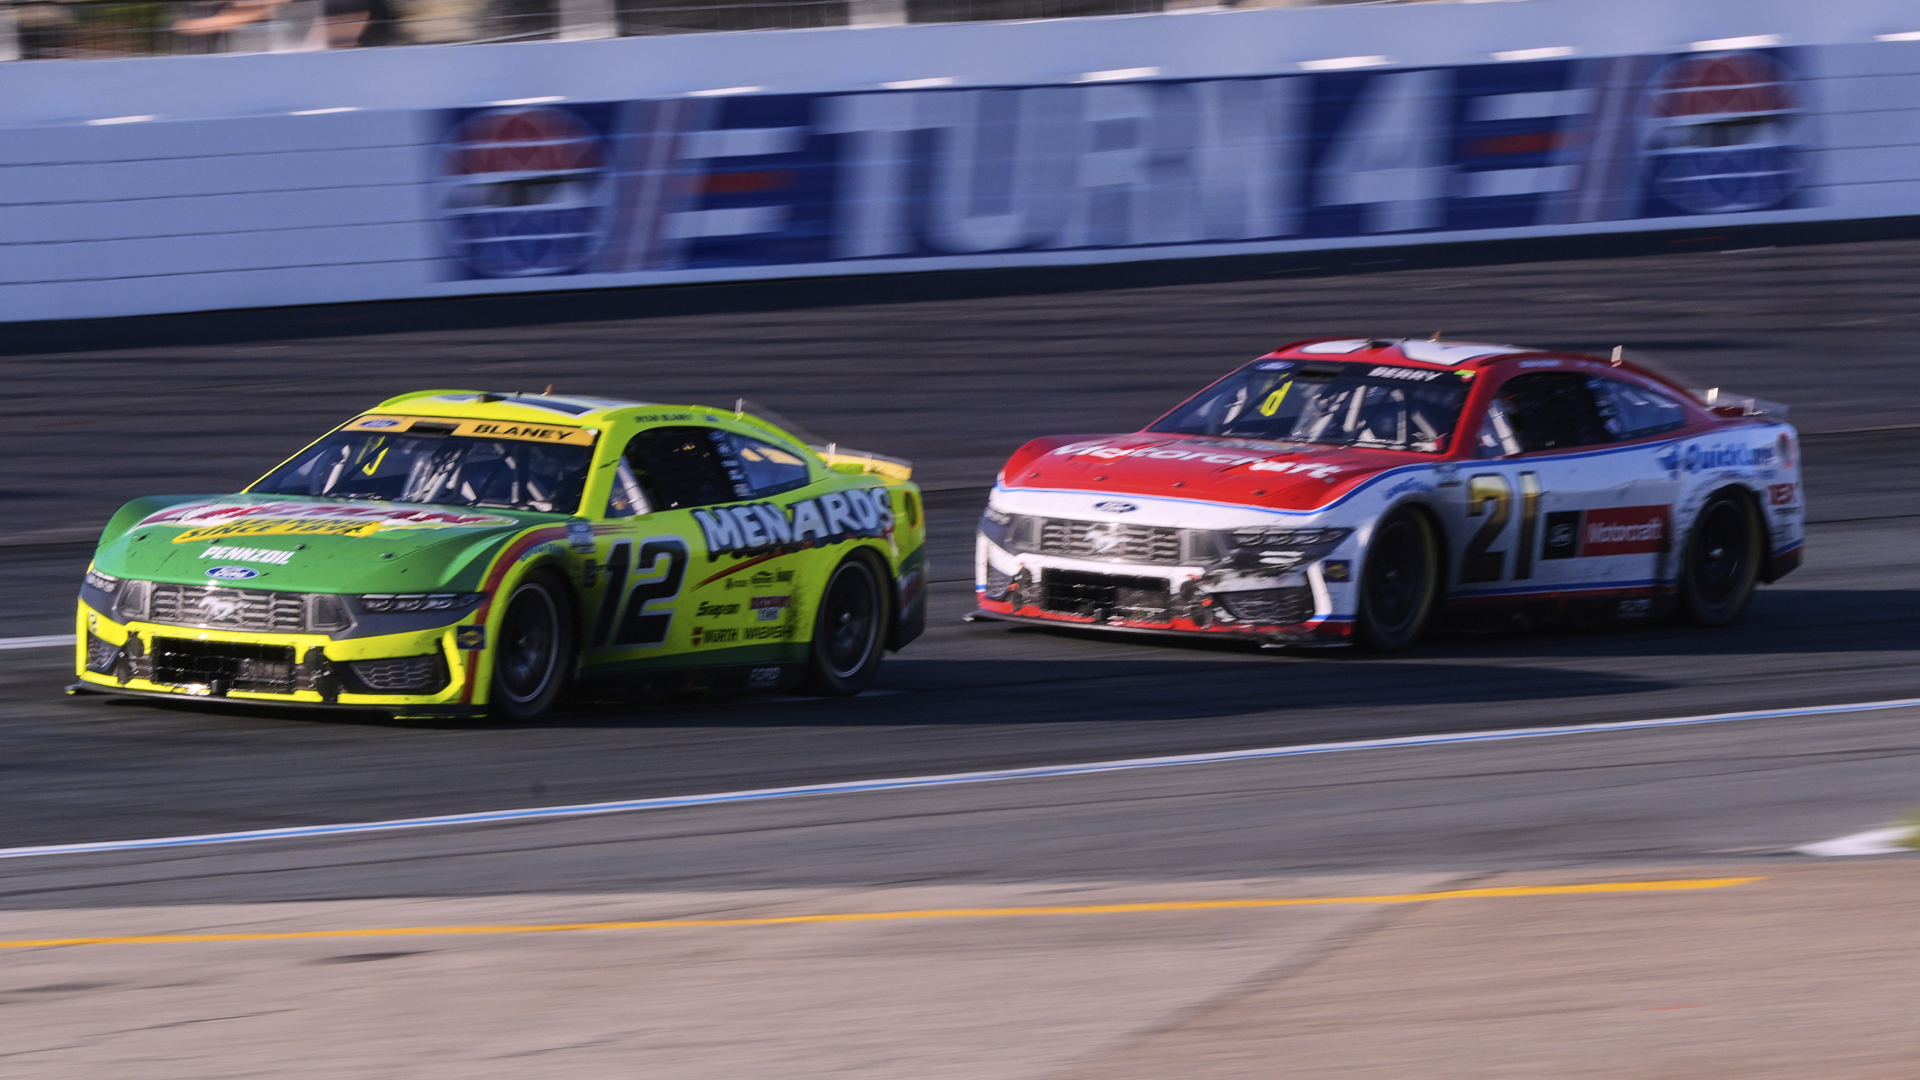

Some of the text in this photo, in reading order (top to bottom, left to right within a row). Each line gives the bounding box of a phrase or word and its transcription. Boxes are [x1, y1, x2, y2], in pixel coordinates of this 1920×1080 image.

[836, 80, 1298, 260] TURN
[1368, 366, 1443, 381] BERRY
[472, 424, 573, 440] BLANEY
[198, 546, 296, 565] PENNZOIL
[692, 486, 893, 557] MENARDS
[1459, 471, 1544, 585] 21
[595, 535, 690, 647] 12
